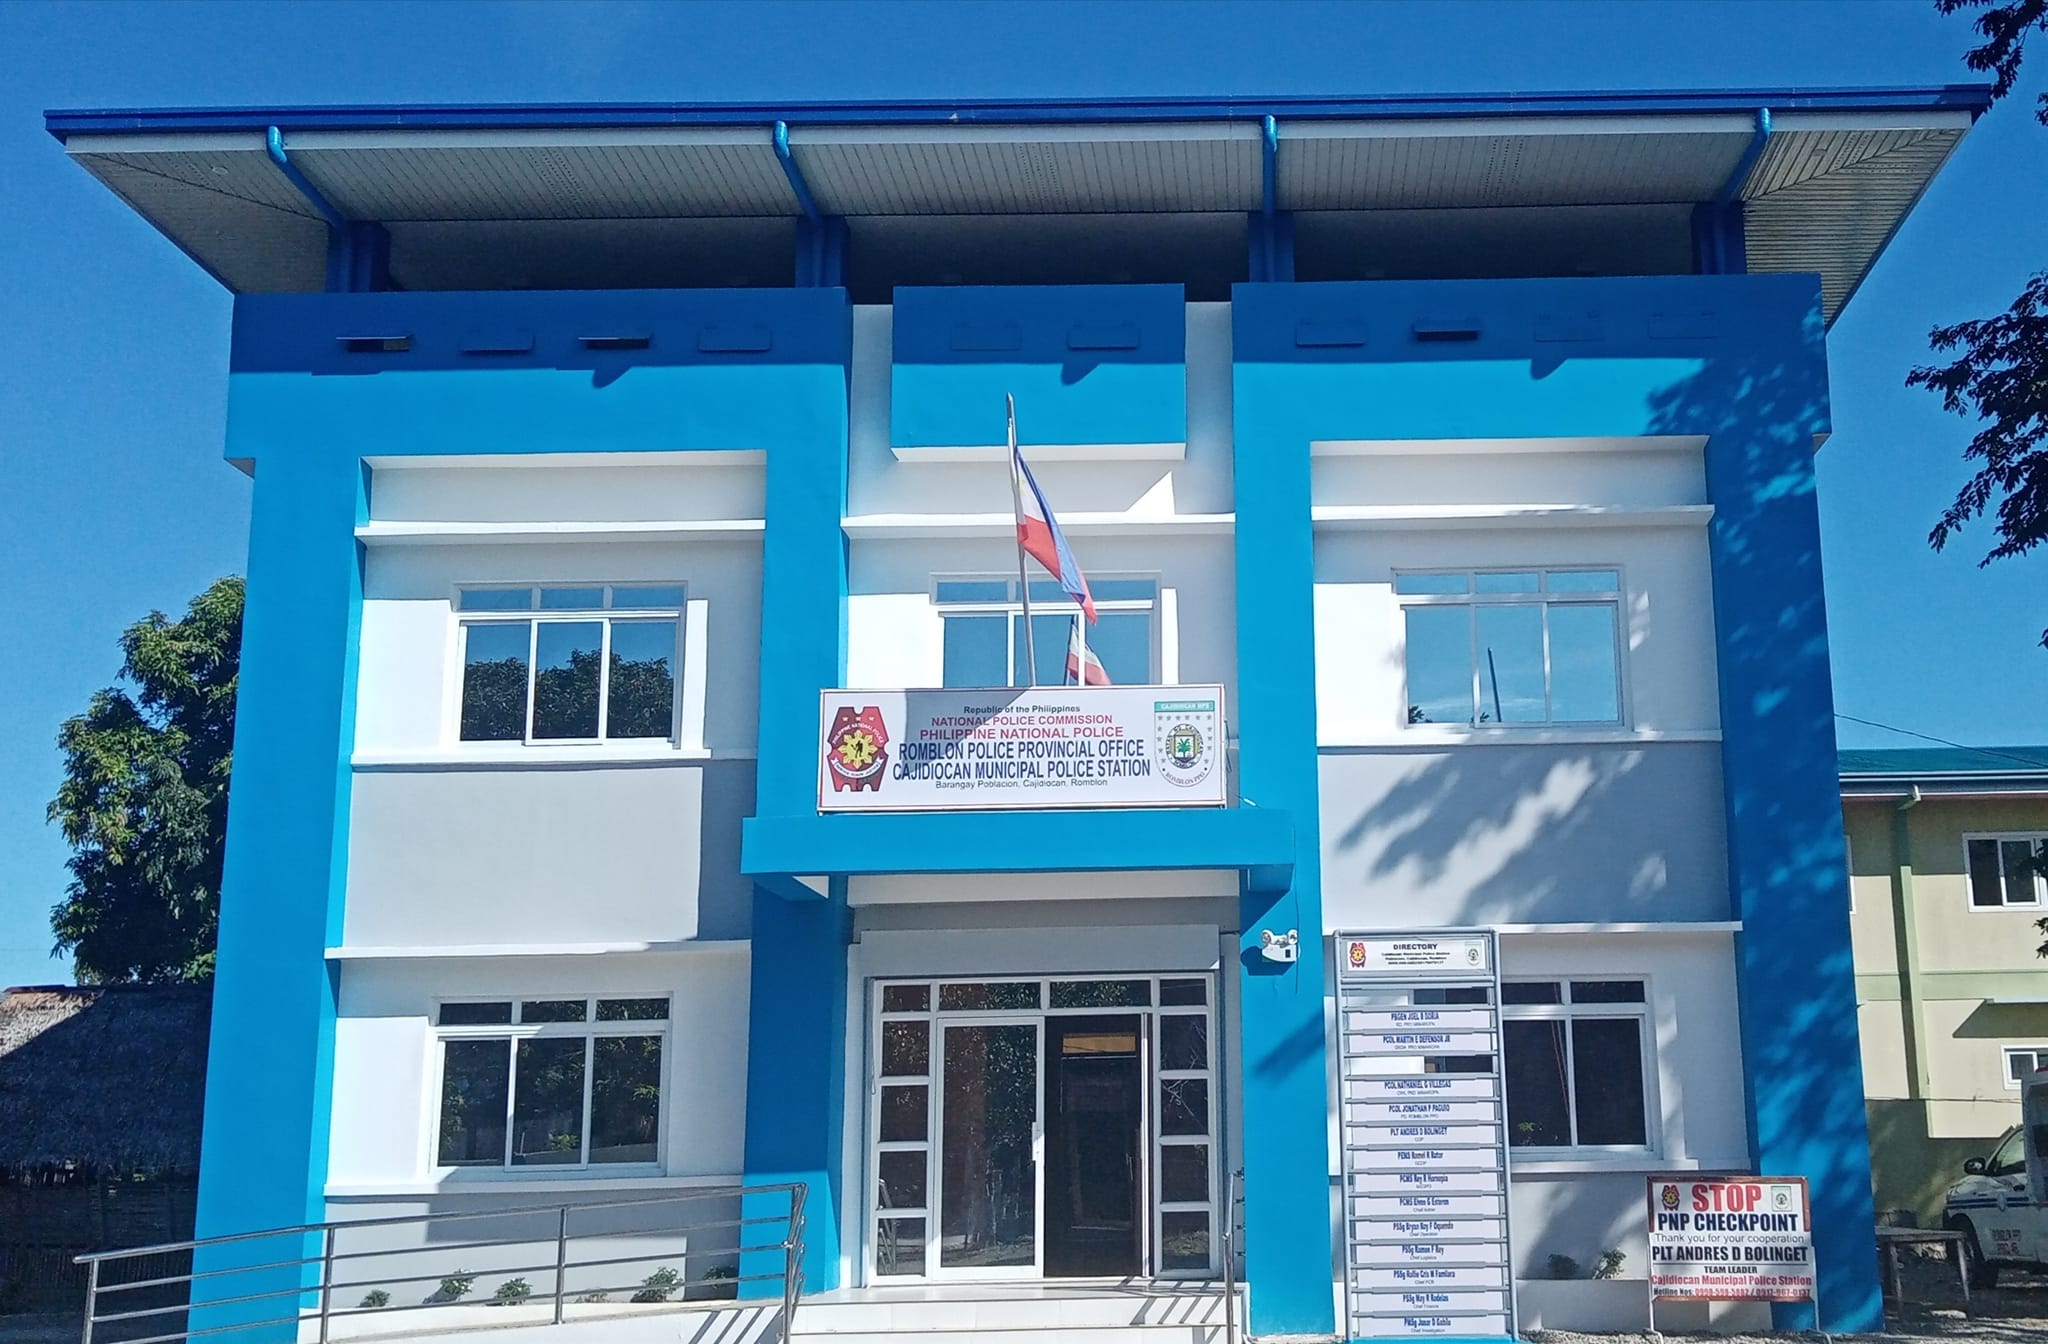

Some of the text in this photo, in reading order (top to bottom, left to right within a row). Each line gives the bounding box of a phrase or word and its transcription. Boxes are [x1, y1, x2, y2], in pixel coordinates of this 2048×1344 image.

[964, 706, 1002, 715] Republic
[1032, 705, 1080, 714] Philippines
[932, 715, 1112, 726] NATIONAL POLICE COMMISSION
[920, 726, 1124, 740] PHILIPPINE NATIONAL POLICE
[899, 740, 1144, 760] ROMBLON POLICE PROVINCIAL OFFICE
[892, 759, 1150, 780] CAJIDIOCAN MUNICIPAL POLICE STATION
[936, 781, 975, 790] Barangay
[1070, 778, 1108, 786] Romblon
[1692, 1184, 1762, 1212] STOP
[1658, 1213, 1798, 1231] PNP CHECKPOINT
[1655, 1233, 1804, 1245] Thank you for your cooperation
[1652, 1246, 1808, 1262] PLT ANDRES D BOLINGET
[1704, 1266, 1758, 1274] TEAM LEADER
[1651, 1275, 1812, 1286] Cajidiocan Municipal Police Station
